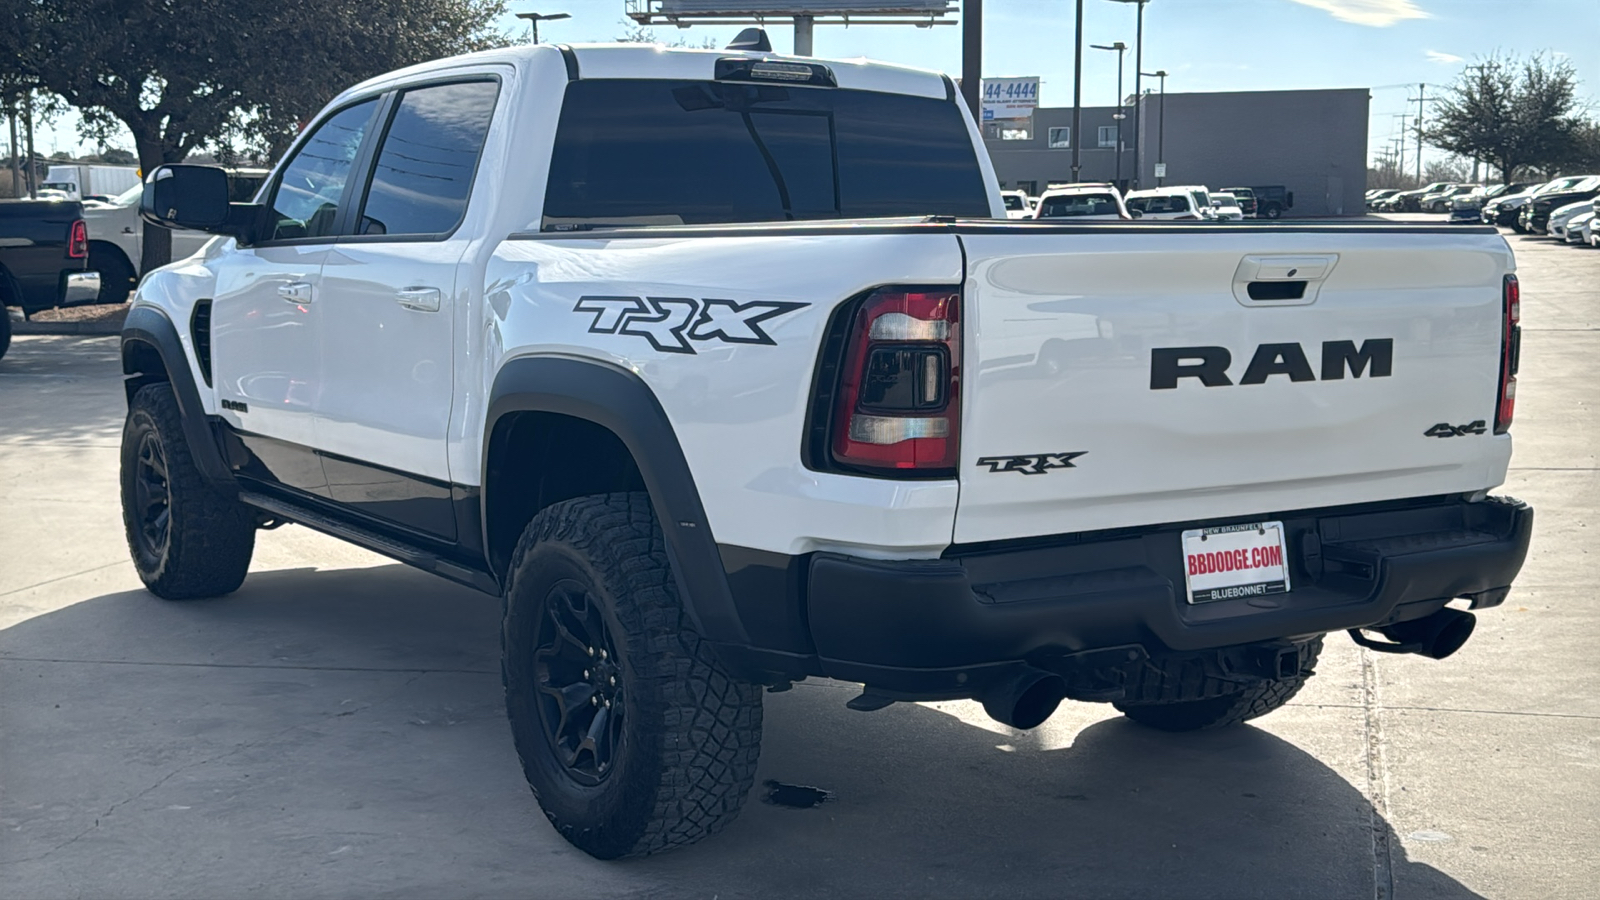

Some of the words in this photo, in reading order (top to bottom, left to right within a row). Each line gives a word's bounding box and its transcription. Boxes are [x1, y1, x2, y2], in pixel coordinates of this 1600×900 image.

[984, 83, 1037, 98] 44-4444
[573, 296, 812, 355] TRX
[1150, 338, 1393, 390] RAM
[976, 451, 1089, 475] TRX
[1203, 527, 1220, 535] NEW
[1221, 523, 1263, 533] BRAUNFELS
[1188, 546, 1282, 575] BBDODGE.COM
[1211, 584, 1267, 599] BLUEBONNET
